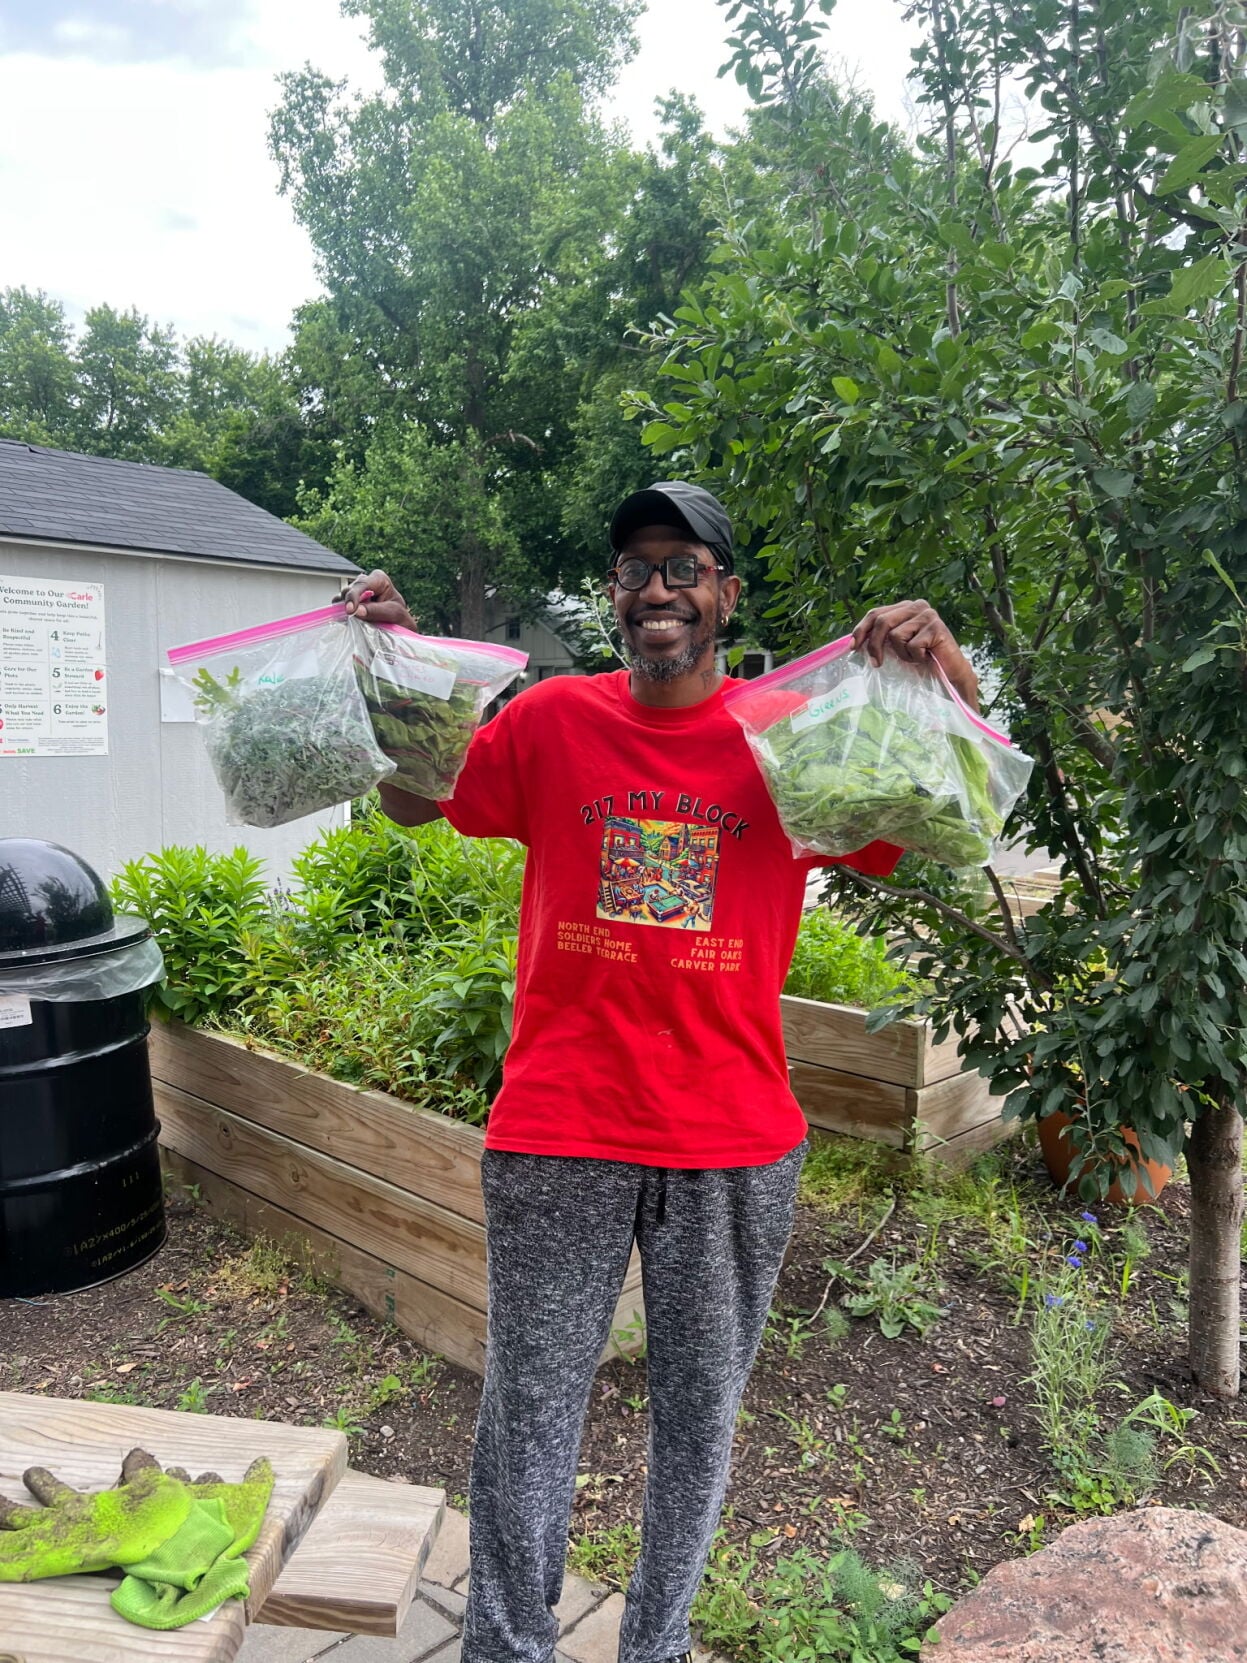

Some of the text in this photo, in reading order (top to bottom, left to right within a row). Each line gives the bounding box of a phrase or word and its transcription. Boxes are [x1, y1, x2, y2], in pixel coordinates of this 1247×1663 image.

[37, 589, 46, 597] to
[48, 590, 64, 598] Our
[70, 592, 93, 601] Carle
[3, 596, 89, 609] Community Garden!
[50, 630, 59, 641] 4
[52, 667, 61, 678] 5
[53, 704, 62, 715] 6
[580, 791, 750, 841] 217 MY BLOCK
[558, 921, 611, 937] NORTH END
[557, 931, 633, 952] SOLDIERS HOME
[695, 936, 744, 949] EAST END
[557, 941, 638, 963] BEELER TERRACE
[690, 947, 743, 960] FAIR OAKS
[670, 958, 741, 972] CARVER PARK
